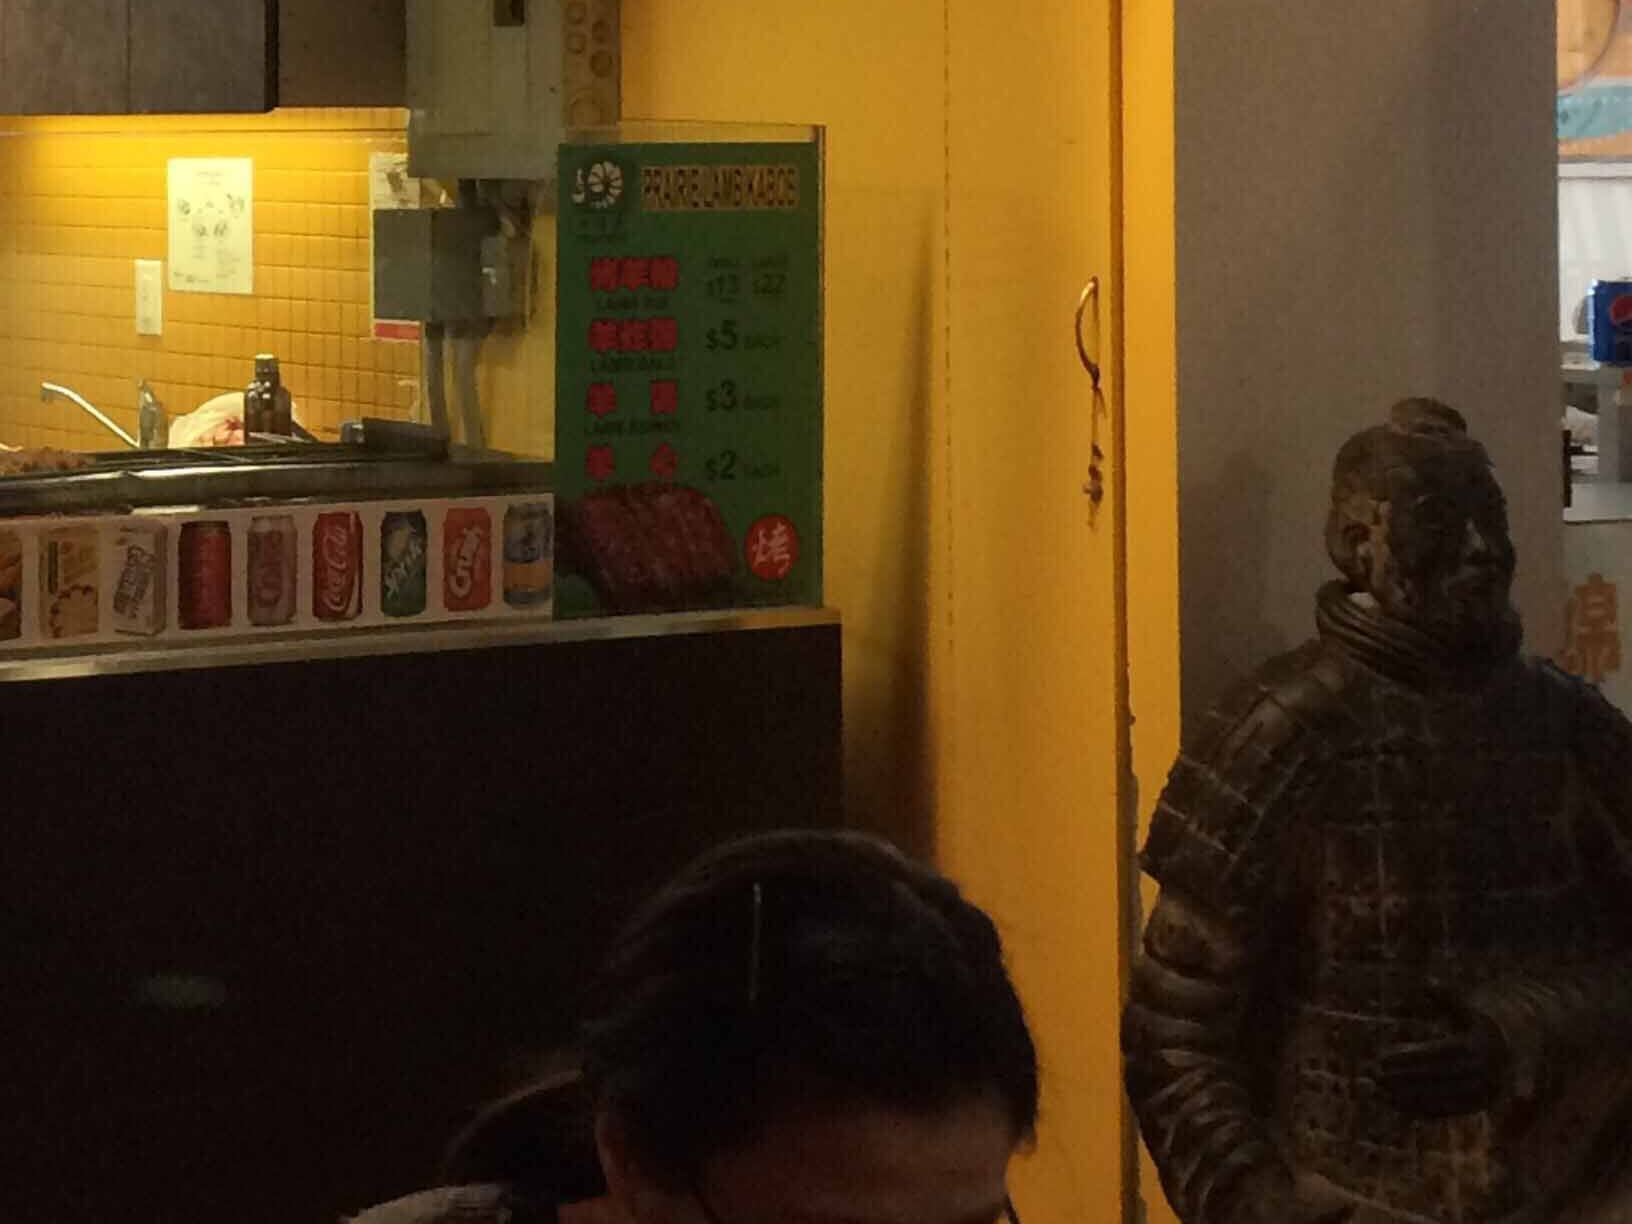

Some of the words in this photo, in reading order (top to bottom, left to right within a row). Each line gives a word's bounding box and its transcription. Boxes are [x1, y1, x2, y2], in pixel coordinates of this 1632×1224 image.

[705, 319, 738, 352] $5
[705, 379, 738, 412] $3
[705, 449, 737, 481] $2
